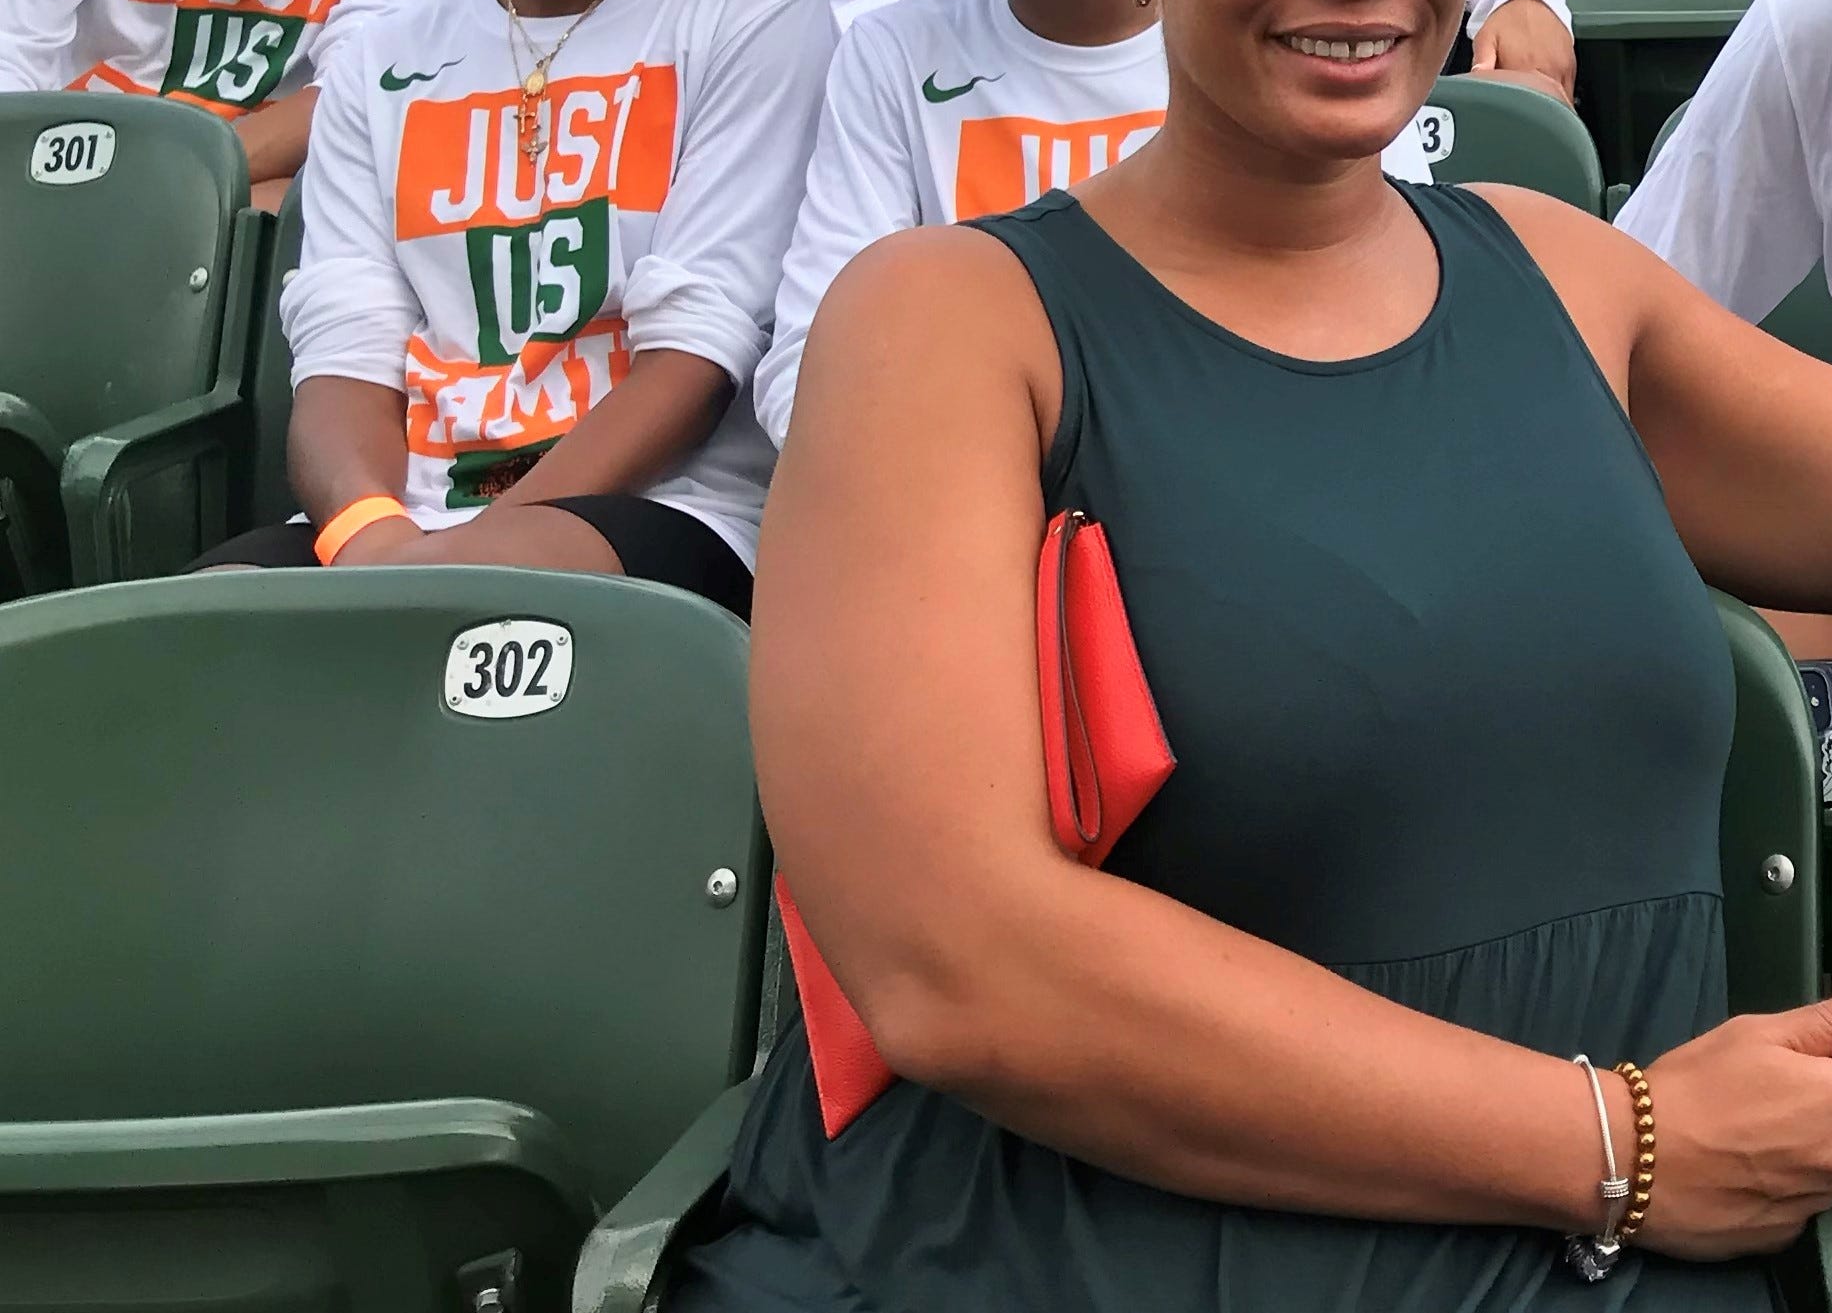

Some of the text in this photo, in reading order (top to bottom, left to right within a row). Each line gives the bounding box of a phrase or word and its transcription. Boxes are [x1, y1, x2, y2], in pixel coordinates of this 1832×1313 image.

[182, 13, 285, 102] US
[44, 135, 99, 173] 301
[430, 74, 642, 224] JUST
[492, 216, 585, 356] US
[463, 639, 554, 699] 302
